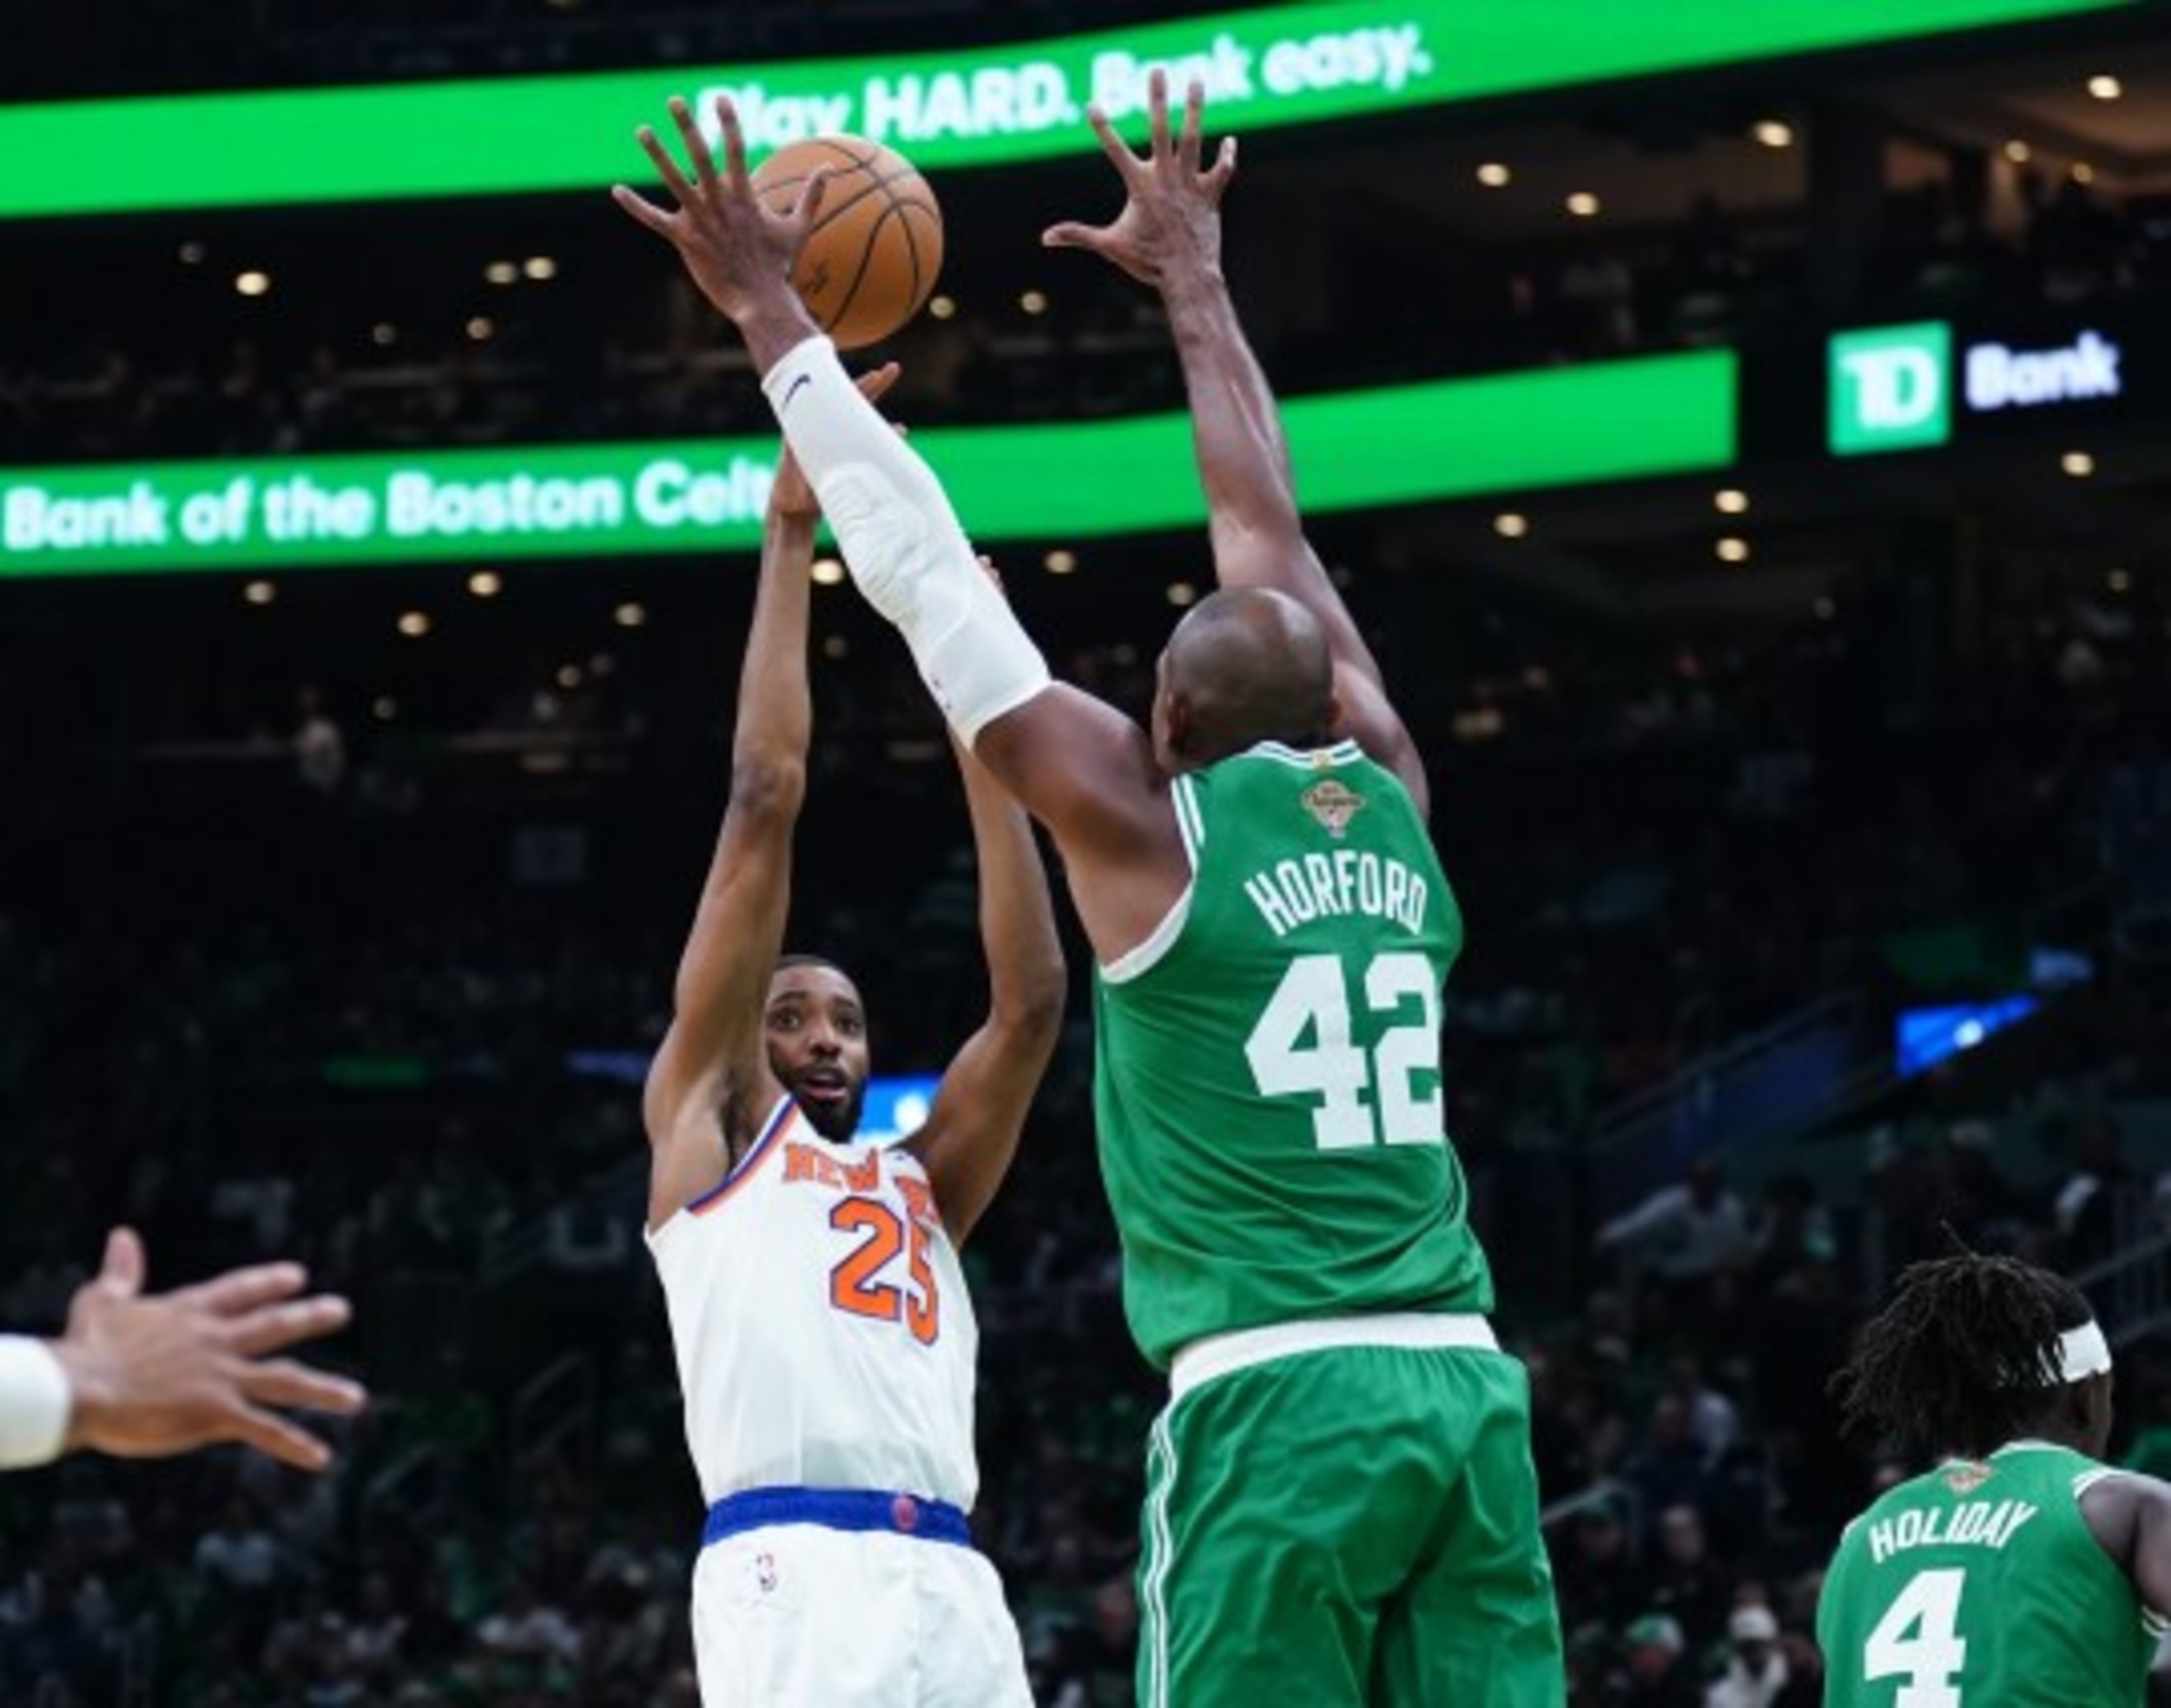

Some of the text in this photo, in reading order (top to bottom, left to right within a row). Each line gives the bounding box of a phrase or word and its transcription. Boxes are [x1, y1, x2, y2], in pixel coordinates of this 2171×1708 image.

[865, 63, 1079, 142] HARD.
[1091, 33, 1253, 118] Bank
[1262, 23, 1434, 94] easy.
[1837, 329, 2119, 428] TD Bank
[4, 480, 168, 550] Bank
[180, 475, 253, 544] of
[265, 474, 375, 541] the
[387, 470, 623, 535] Boston
[1244, 849, 1427, 937] HORFORD
[1244, 952, 1444, 1150] 42
[782, 1142, 879, 1192] NEW
[828, 1195, 939, 1345] 25
[1869, 1499, 2038, 1563] HOLIDAY
[1864, 1568, 1967, 1708] 4
